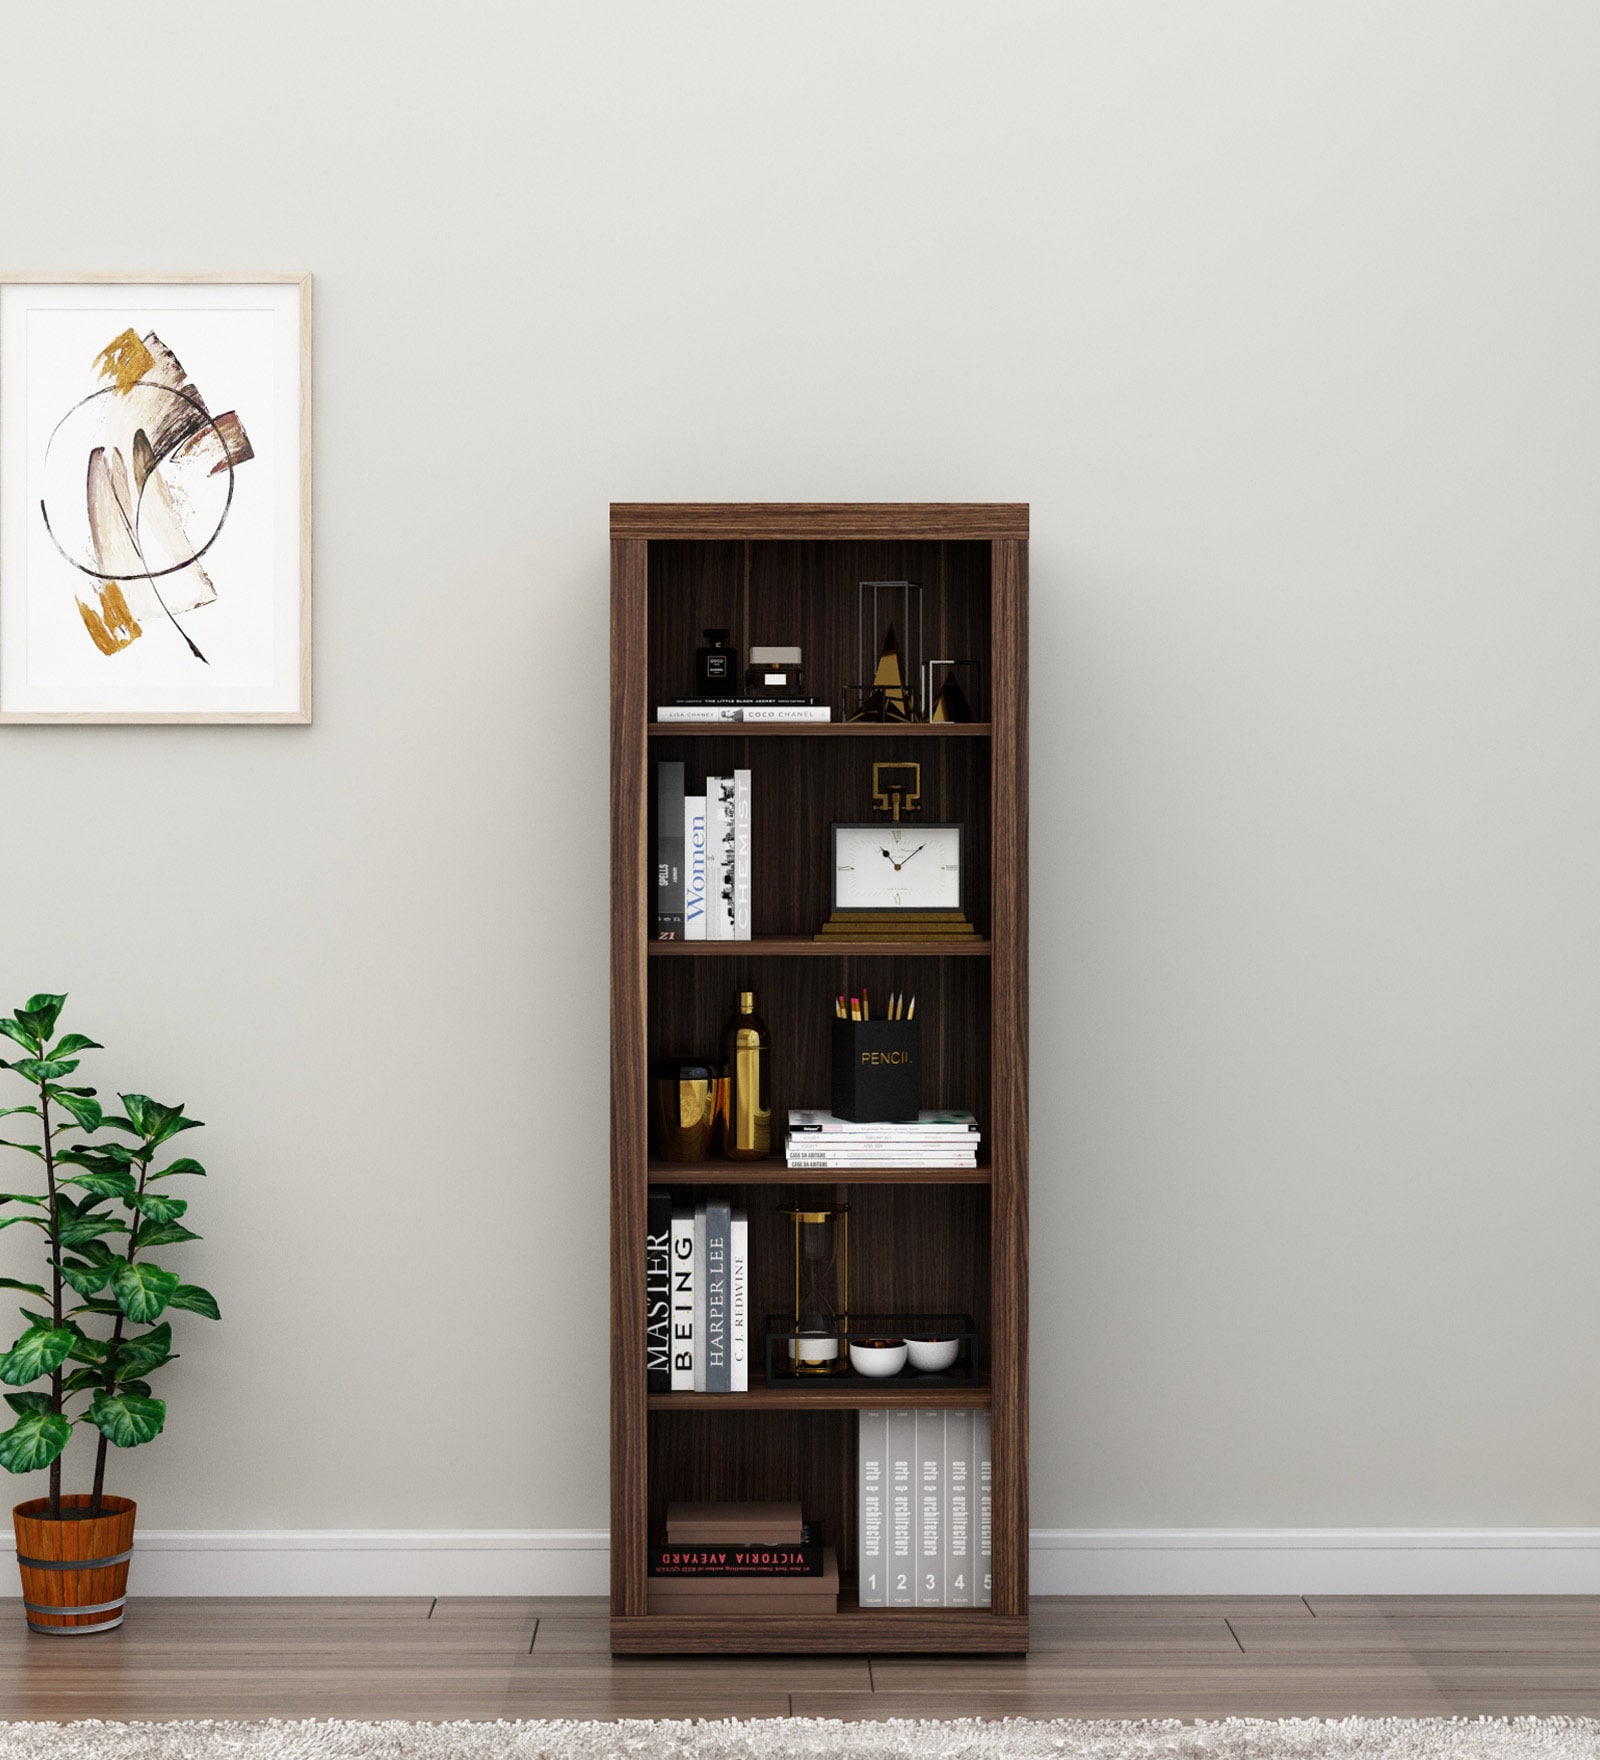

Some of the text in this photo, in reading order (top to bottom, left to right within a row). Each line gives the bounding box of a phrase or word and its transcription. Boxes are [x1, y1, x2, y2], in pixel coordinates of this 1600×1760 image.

[738, 779, 749, 929] CHEMIST
[658, 863, 669, 887] SPELLS
[687, 816, 705, 922] Women
[647, 1229, 670, 1374] MASTER
[710, 1237, 724, 1367] HARPER LEE
[735, 1255, 744, 1327] REDWINE
[675, 1237, 693, 1371] BEING
[735, 1349, 744, 1362] C.
[865, 1461, 881, 1481] arts
[894, 1461, 910, 1481] arts
[923, 1461, 939, 1481] arts
[952, 1461, 967, 1481] arts
[865, 1496, 882, 1556] architecture
[894, 1496, 911, 1556] architecture
[923, 1496, 940, 1556] architecture
[952, 1496, 969, 1556] architecture
[662, 1553, 804, 1564] VICTORIA AVEYARD
[868, 1574, 876, 1590] 1
[896, 1574, 907, 1590] 2
[926, 1574, 936, 1590] 3
[954, 1574, 965, 1590] 4
[983, 1574, 992, 1590] 5
